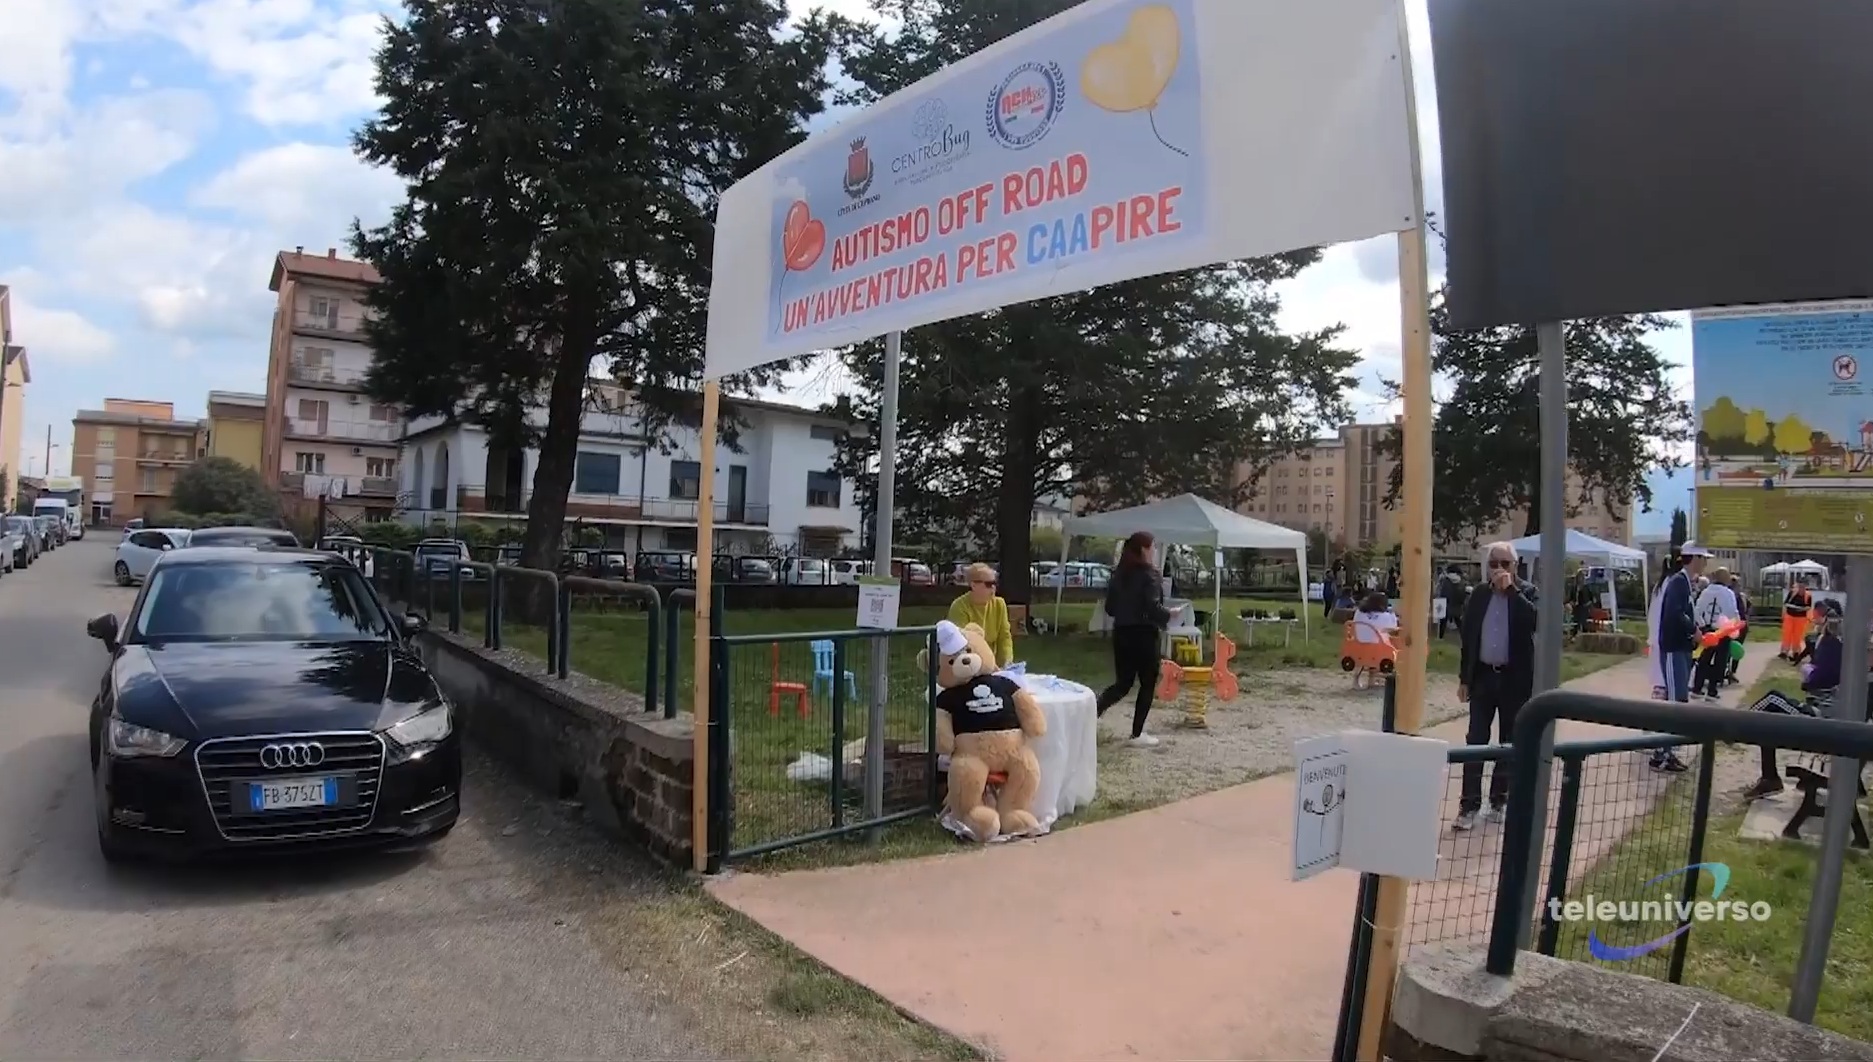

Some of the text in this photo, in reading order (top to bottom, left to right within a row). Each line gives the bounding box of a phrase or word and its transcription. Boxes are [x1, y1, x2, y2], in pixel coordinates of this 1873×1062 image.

[783, 187, 1182, 333] UN'AVVENTURA PER CAAPIRE
[831, 206, 930, 272] AUTISMO
[938, 183, 994, 235] OFF
[1003, 153, 1088, 215] ROAD
